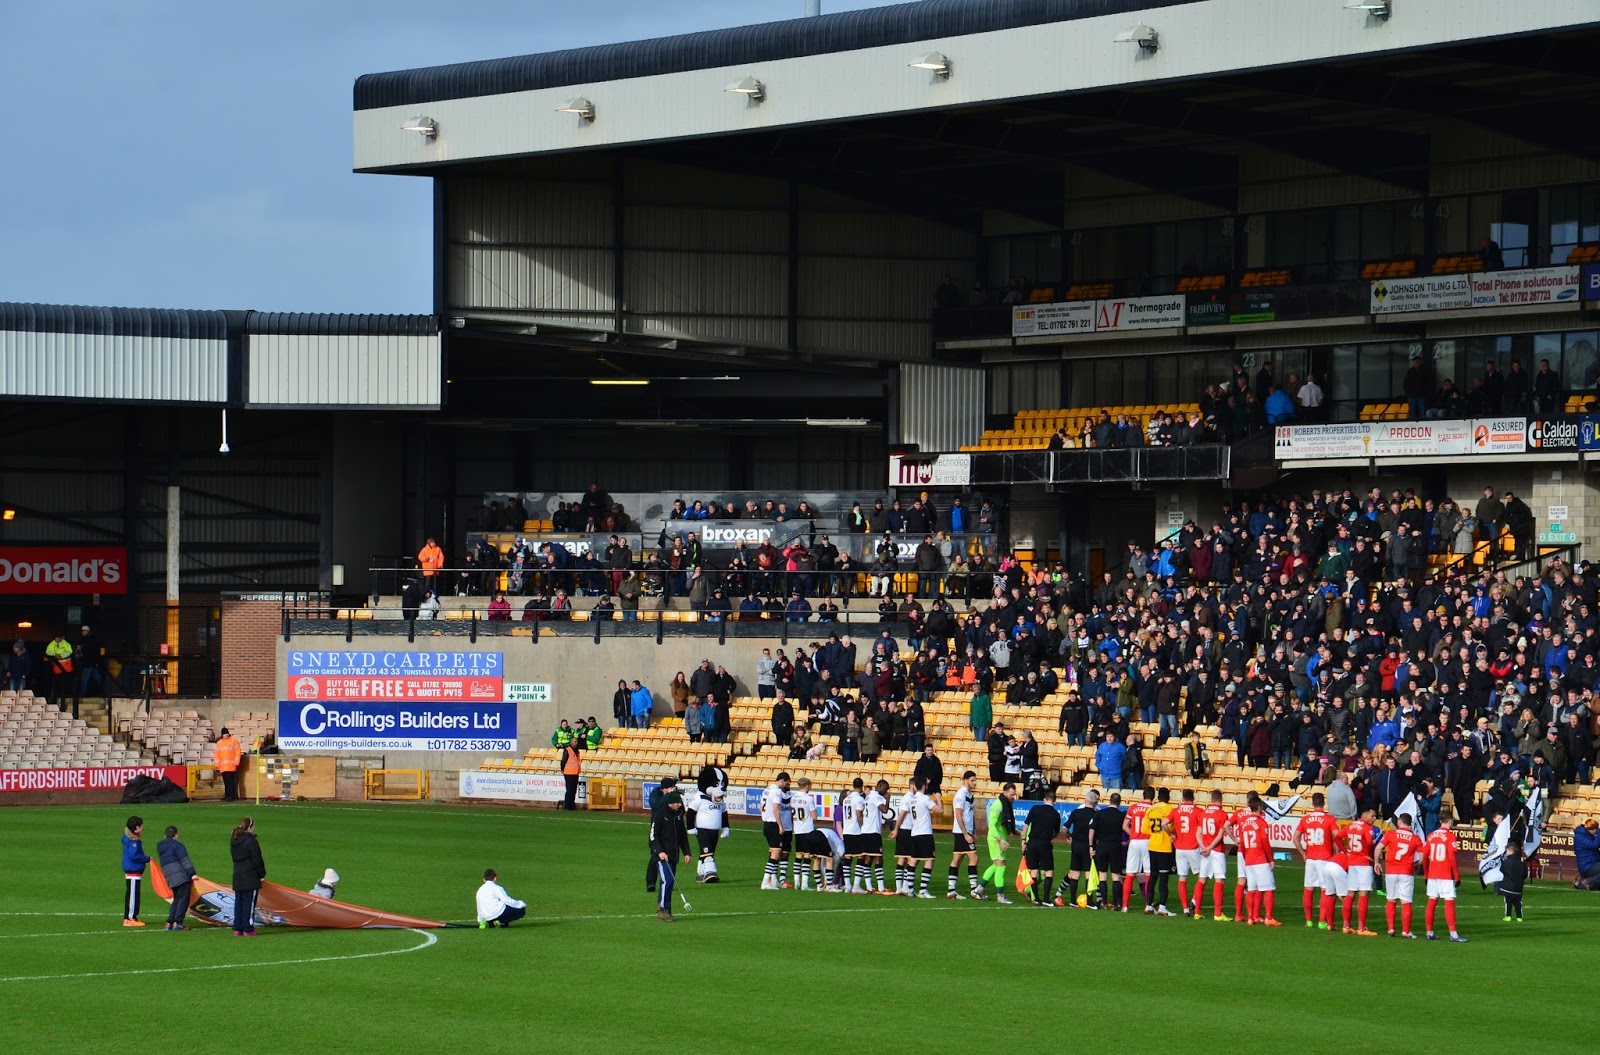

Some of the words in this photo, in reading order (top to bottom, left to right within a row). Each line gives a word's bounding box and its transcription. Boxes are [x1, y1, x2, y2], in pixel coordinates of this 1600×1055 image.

[1389, 283, 1425, 294] JOHNSON
[1426, 281, 1451, 292] TILING
[1452, 280, 1469, 290] LTD.
[1473, 280, 1492, 291] Total
[1494, 279, 1521, 290] Phone
[1523, 276, 1563, 288] solutions
[1565, 274, 1580, 285] Ltd
[1590, 274, 1600, 288] B
[1473, 296, 1496, 304] NOKIA
[1499, 292, 1509, 303] Tel:
[1128, 301, 1181, 314] Thermograde
[1189, 303, 1226, 314] FRESHVIEW
[1037, 322, 1049, 330] TEL:
[1049, 320, 1067, 330] 01782
[1068, 319, 1079, 328] 761
[1080, 319, 1091, 328] 221
[1128, 316, 1181, 324] www.thermograde.com
[1243, 352, 1255, 368] 23
[1294, 427, 1321, 436] ROBERTS
[1321, 425, 1357, 435] PROPERTIES
[1358, 425, 1371, 433] LTD
[1390, 426, 1432, 438] PROCON
[1492, 421, 1524, 432] ASSURED
[1543, 420, 1578, 438] Caldan
[1594, 422, 1600, 440] L
[1543, 438, 1577, 448] ELECTRICAL
[702, 525, 771, 544] broxap
[1548, 532, 1567, 542] EXIT
[292, 652, 376, 667] SNEYD
[383, 652, 497, 668] CARPETS
[342, 667, 366, 675] 01782
[367, 667, 377, 675] 20
[432, 668, 456, 676] 01782
[457, 668, 467, 676] 83
[469, 668, 479, 676] 78
[481, 668, 490, 676] 74
[326, 679, 342, 688] BUY
[361, 680, 404, 697] FREE
[326, 688, 343, 697] GET
[344, 688, 360, 696] ONE
[407, 689, 415, 697] &
[416, 688, 442, 697] QUOTE
[443, 688, 463, 697] PV15
[399, 711, 470, 729] Builders
[473, 712, 501, 729] Ltd
[283, 739, 413, 749] www.c-rollings-builders.co.uk
[470, 740, 511, 751] 538790
[761, 798, 767, 812] 2
[791, 807, 805, 821] 20
[911, 805, 917, 820] 6
[1149, 818, 1162, 834] 23
[1180, 815, 1190, 834] 3
[1202, 817, 1216, 836] 16
[1243, 830, 1257, 849] 12
[1306, 827, 1325, 846] 38
[1460, 830, 1474, 838] OUR
[1462, 840, 1489, 852] BULLS
[1552, 836, 1567, 846] DAY
[1394, 842, 1409, 861] 7
[1430, 842, 1446, 862] 10
[1540, 847, 1560, 856] SQUARE
